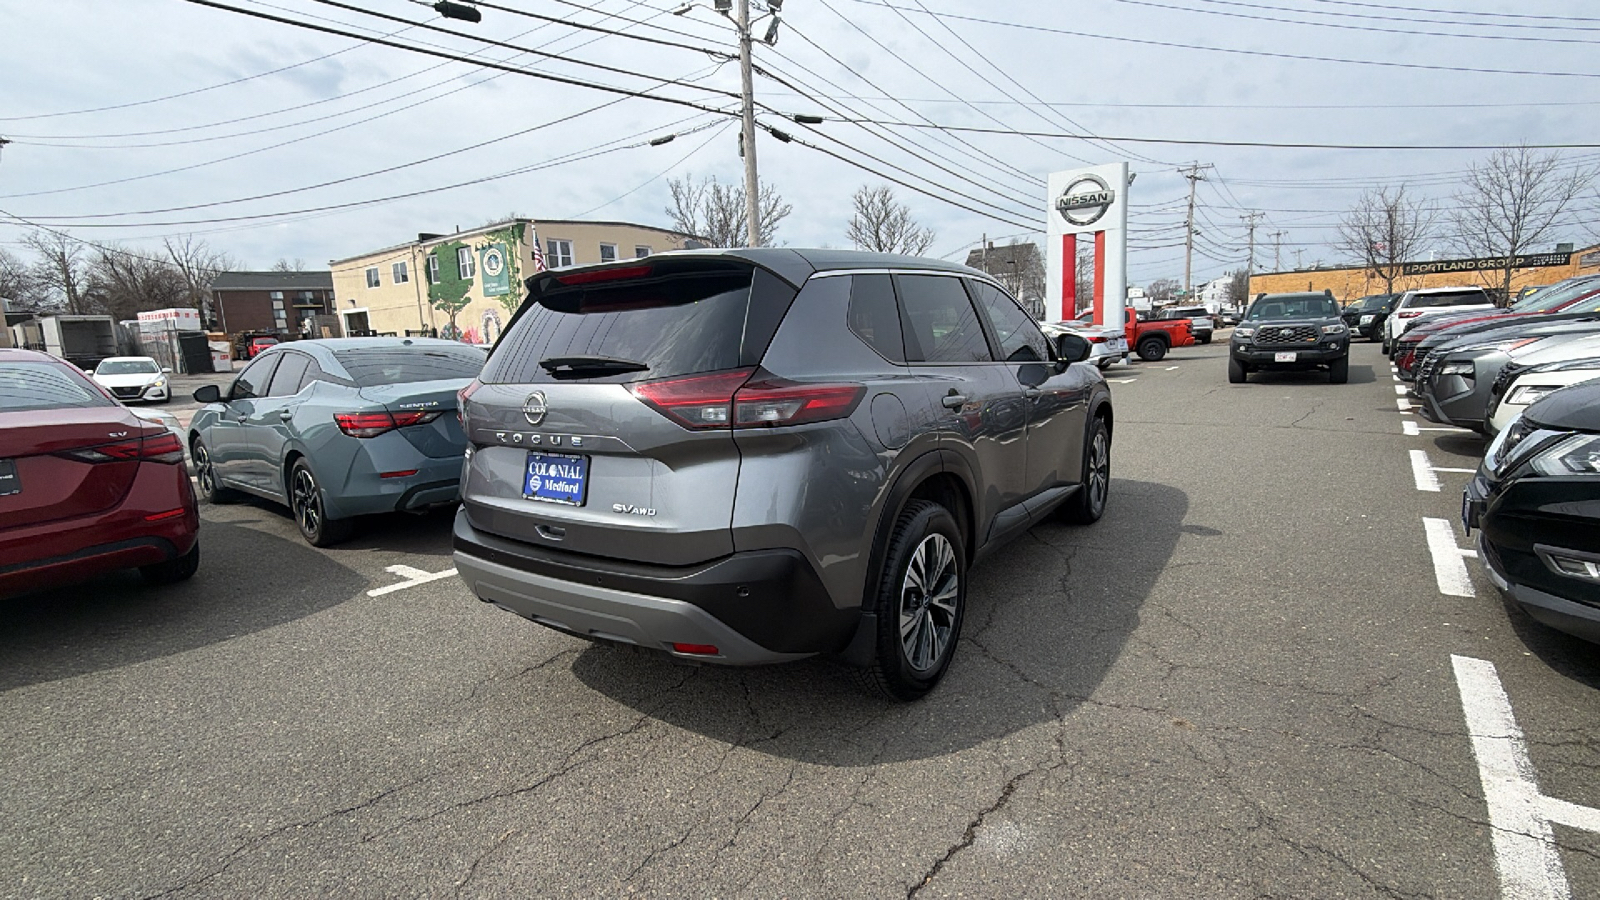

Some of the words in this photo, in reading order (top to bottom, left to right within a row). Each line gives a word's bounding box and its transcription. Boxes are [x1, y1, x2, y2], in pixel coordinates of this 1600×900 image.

[1059, 192, 1108, 207] NISSAN
[1411, 258, 1476, 273] PORTLAND
[496, 432, 582, 446] ROGUE
[528, 461, 584, 480] COLONIAL
[543, 479, 580, 494] Medford
[612, 503, 634, 514] SV
[631, 507, 657, 517] AWD
